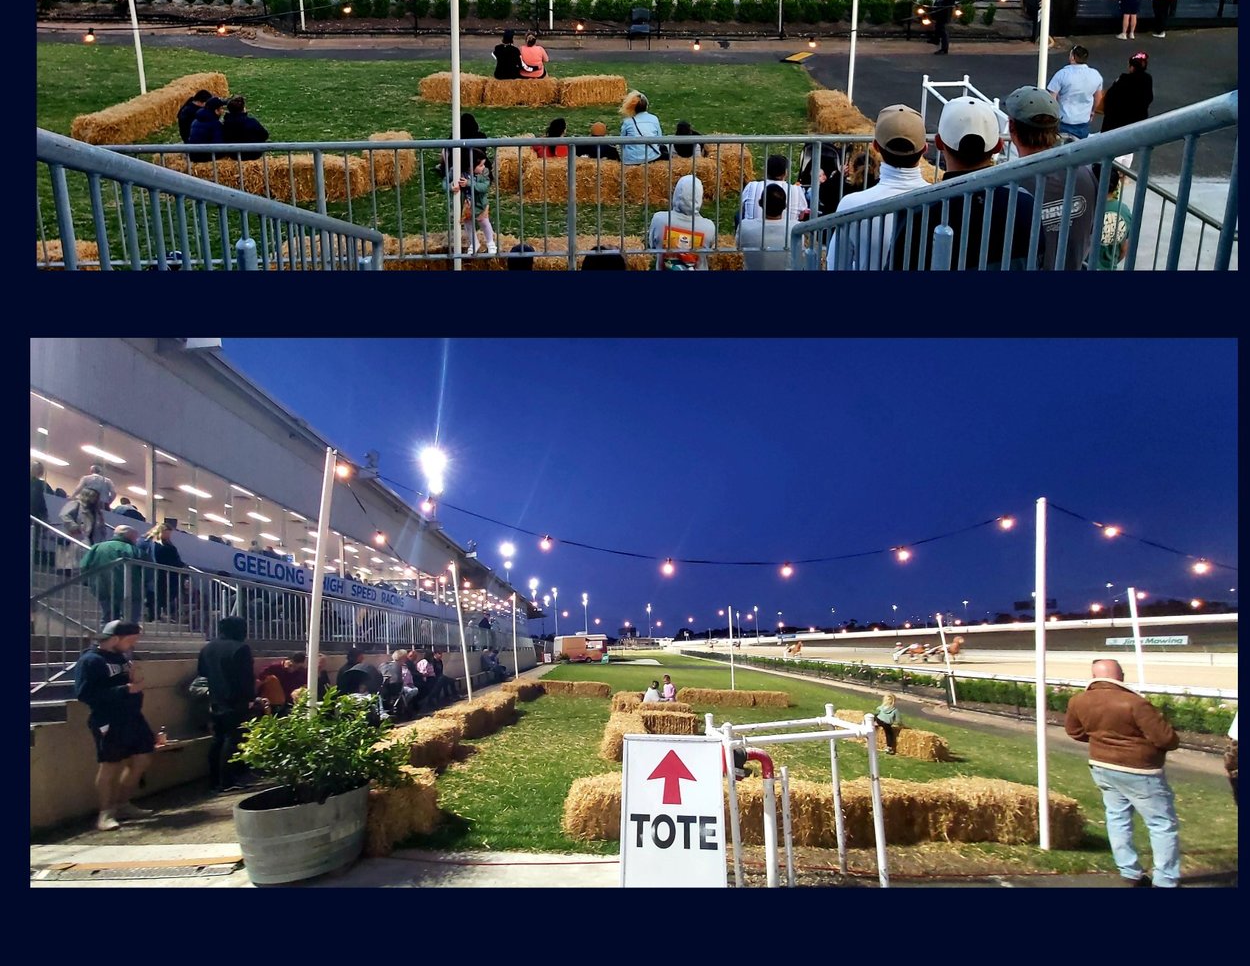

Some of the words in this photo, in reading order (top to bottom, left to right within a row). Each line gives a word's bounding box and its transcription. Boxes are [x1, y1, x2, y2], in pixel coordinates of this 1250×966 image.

[233, 552, 305, 585] GEELONG
[351, 584, 377, 601] SPEED
[381, 592, 405, 607] RACING
[1144, 636, 1183, 645] Mowing
[630, 813, 719, 851] TOTE
